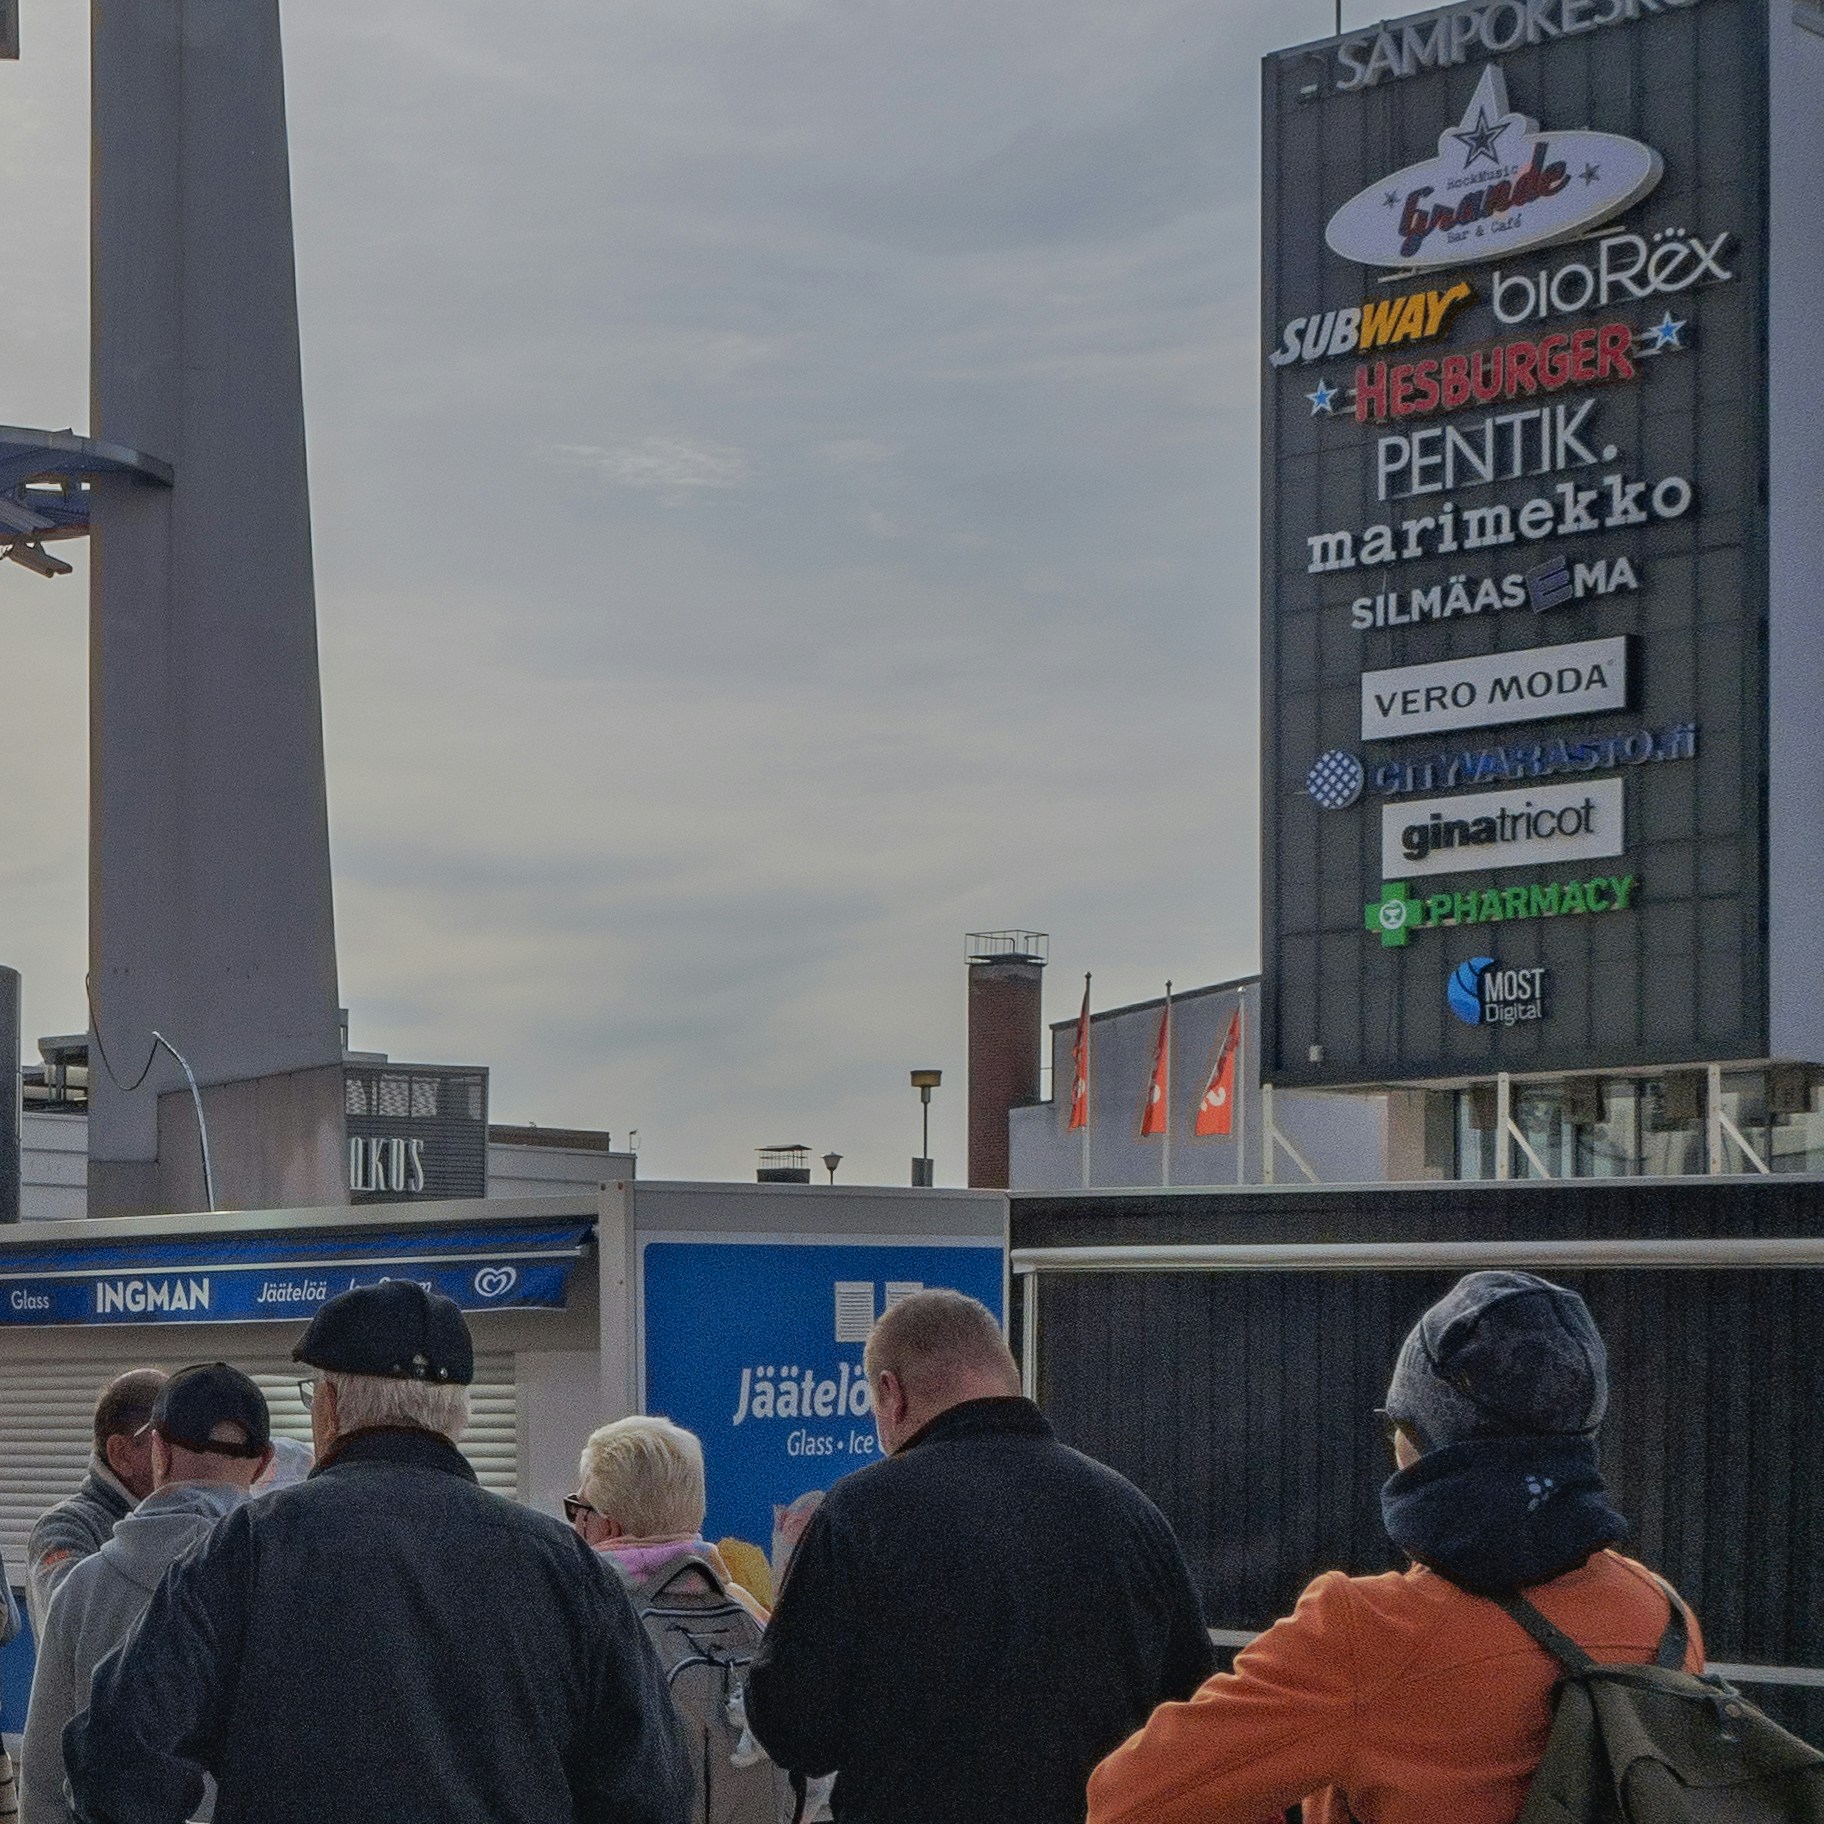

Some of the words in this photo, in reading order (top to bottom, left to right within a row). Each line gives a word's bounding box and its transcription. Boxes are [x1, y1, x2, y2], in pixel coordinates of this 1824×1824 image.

[1398, 141, 1572, 258] Grande
[1448, 230, 1469, 244] Bar
[1476, 225, 1485, 237] &
[1491, 213, 1523, 233] Café
[1269, 281, 1471, 367] SUBWAY
[1353, 323, 1635, 423] HESBURGER
[1307, 473, 1692, 574] marimekko
[1351, 556, 1639, 630] SILMÄASEMA
[1374, 681, 1476, 718] VERO
[1488, 663, 1609, 703] MODA
[1402, 797, 1596, 860] ginatricot
[1430, 875, 1636, 926] PHARMACY
[1484, 968, 1545, 1002] MOST
[1485, 998, 1542, 1027] Digital
[350, 1137, 424, 1192] OKOS
[10, 1290, 50, 1310] Glass
[96, 1278, 210, 1313] INGMAN
[257, 1281, 326, 1303] Jäätelöä
[733, 1362, 870, 1426] Jäätelö
[787, 1429, 834, 1456] Glass
[849, 1430, 874, 1454] Ice
